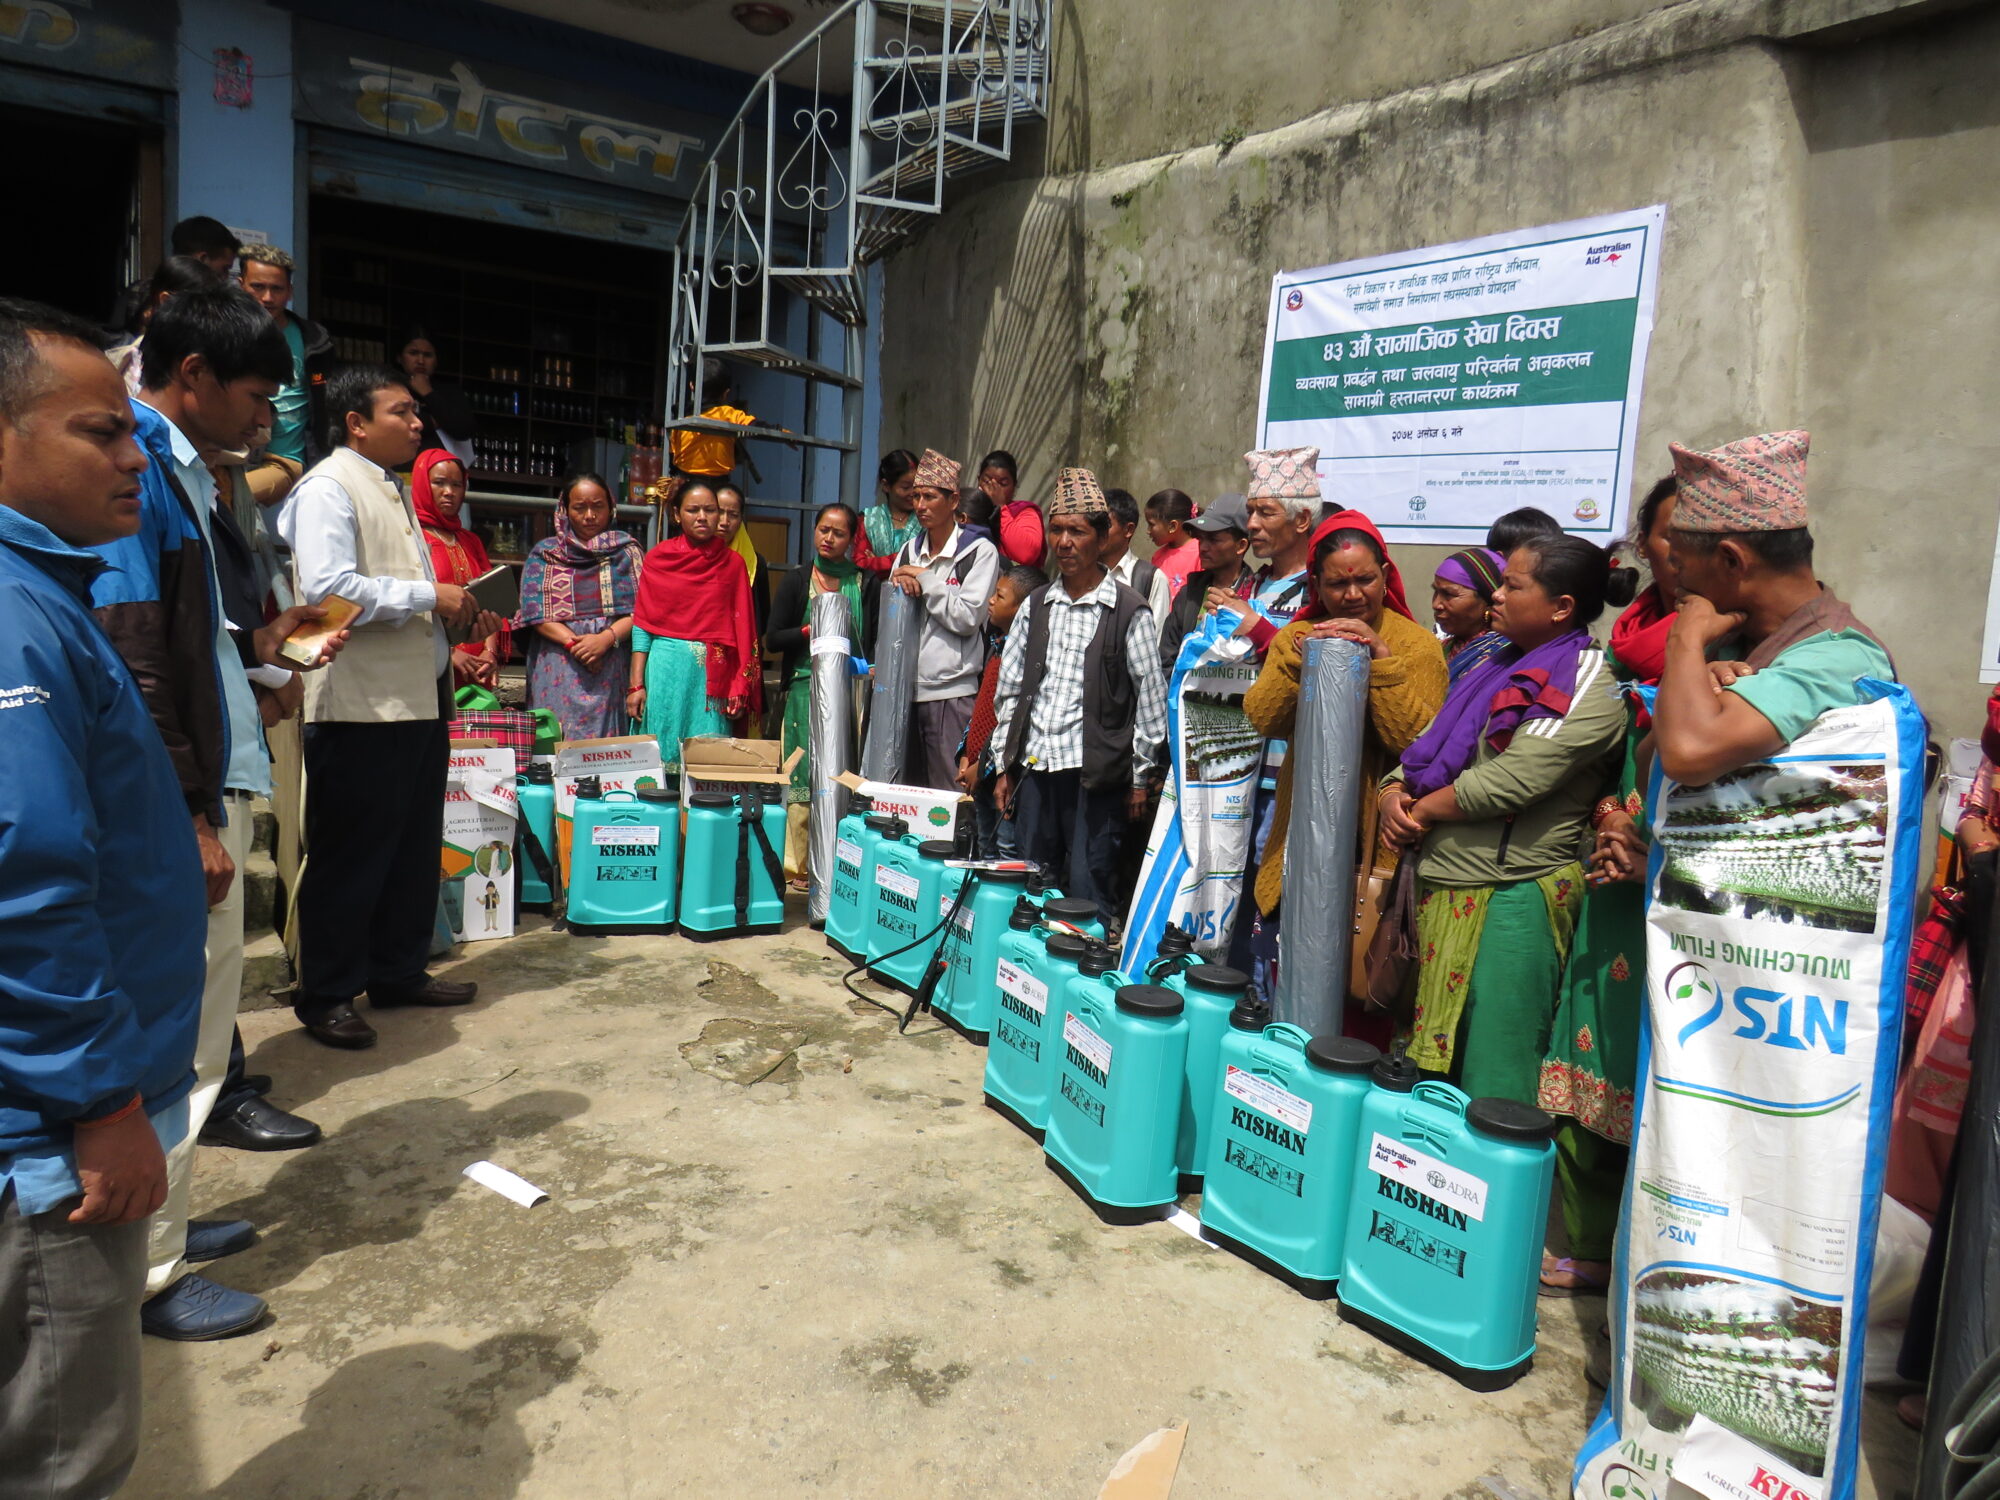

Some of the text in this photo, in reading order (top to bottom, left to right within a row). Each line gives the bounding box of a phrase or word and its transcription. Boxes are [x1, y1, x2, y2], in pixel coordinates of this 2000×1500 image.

[349, 57, 705, 181] होटल
[1587, 242, 1631, 255] Australian
[1585, 256, 1600, 265] Aid
[1323, 343, 1343, 362] ४३
[1374, 325, 1460, 357] सामाजिक
[1464, 321, 1500, 348] सेवा
[1504, 314, 1563, 343] दिवस
[1296, 374, 1338, 391] व्यवसाय
[1381, 368, 1404, 384] तथा
[1411, 363, 1460, 383] जलवायु
[1465, 354, 1521, 377] परिवर्तन
[1343, 382, 1520, 411] सामाग्री हस्तान्तरण कार्यक्रम
[1417, 427, 1439, 439] असोज
[1442, 428, 1447, 439] ६
[1451, 426, 1463, 437] गते
[0, 697, 24, 710] Aid
[448, 756, 485, 768] SHAN
[582, 749, 632, 762] KISHAN
[695, 781, 749, 793] KISHAN
[599, 844, 657, 857] KISHAN
[838, 859, 860, 882] KISHAN
[880, 887, 917, 913] KISHAN
[1181, 911, 1216, 941] NTS
[1670, 931, 1851, 980] MULCHING FILM
[1001, 991, 1042, 1028] KISHAN
[1733, 986, 1849, 1055] NTS
[1066, 1042, 1108, 1089] KISHAN
[1231, 1106, 1307, 1156] KISHAN
[1375, 1152, 1388, 1162] Aid
[1376, 1143, 1416, 1165] Australian
[1377, 1174, 1467, 1232] KISHAN
[1447, 1182, 1479, 1205] ADRA
[1669, 1225, 1696, 1246] NTS
